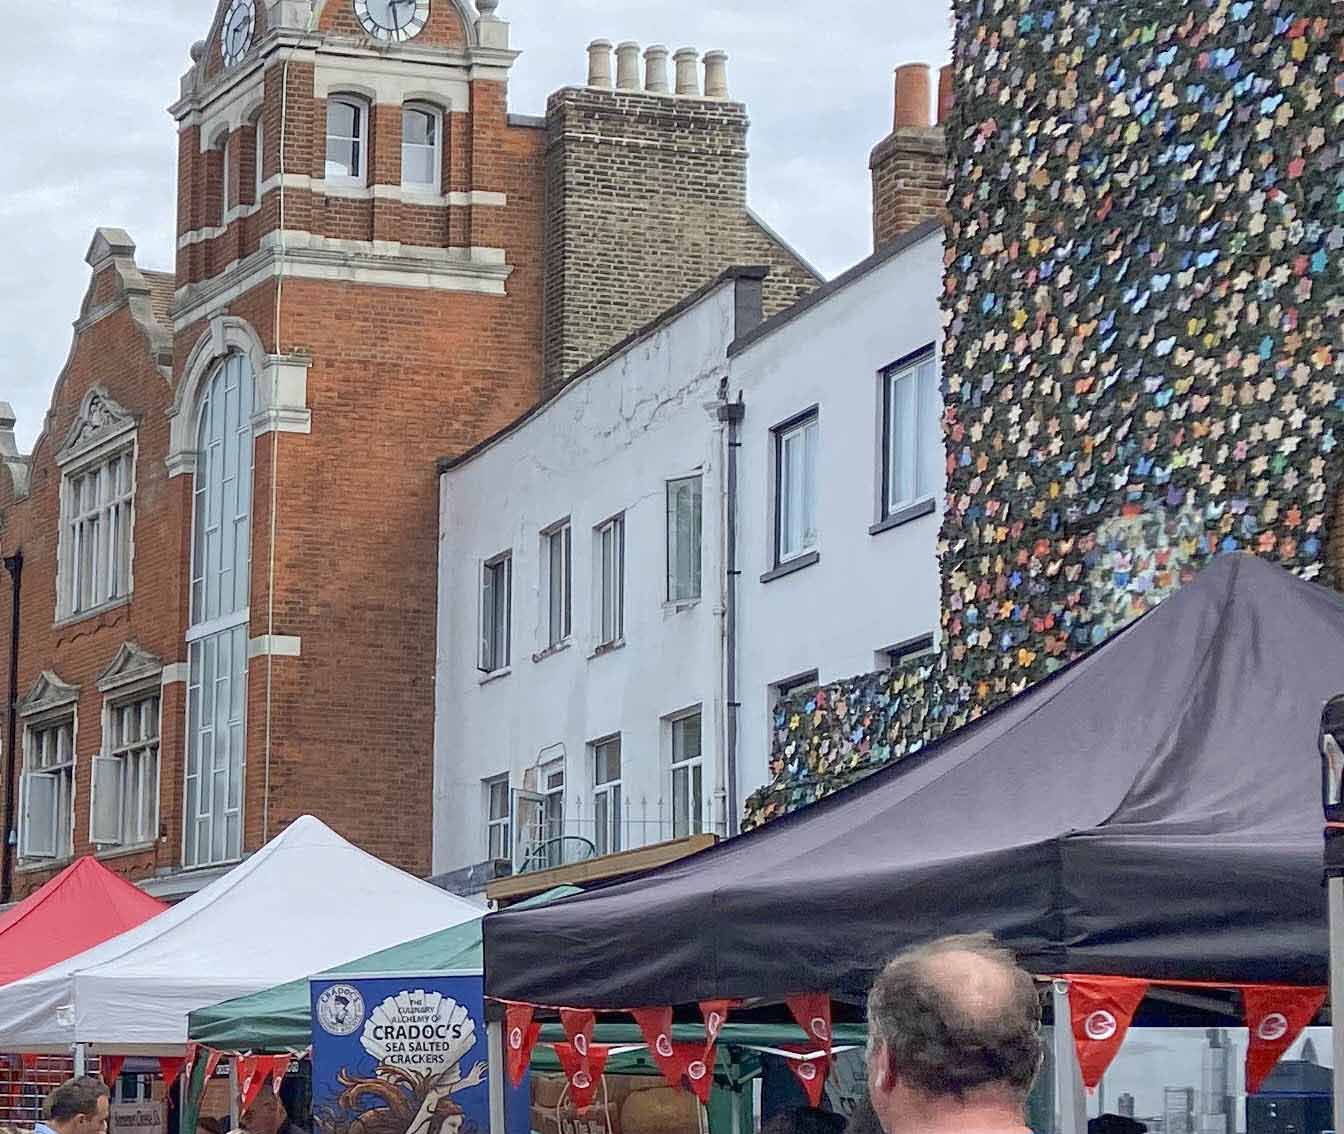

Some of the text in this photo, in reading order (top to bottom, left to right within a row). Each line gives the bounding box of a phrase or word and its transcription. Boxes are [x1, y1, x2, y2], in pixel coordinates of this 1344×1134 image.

[392, 1015, 429, 1023] ALCHEMY
[372, 1024, 462, 1040] CRADOC'S
[385, 1041, 450, 1052] SEA SALTED
[390, 1054, 444, 1064] CRACKERS
